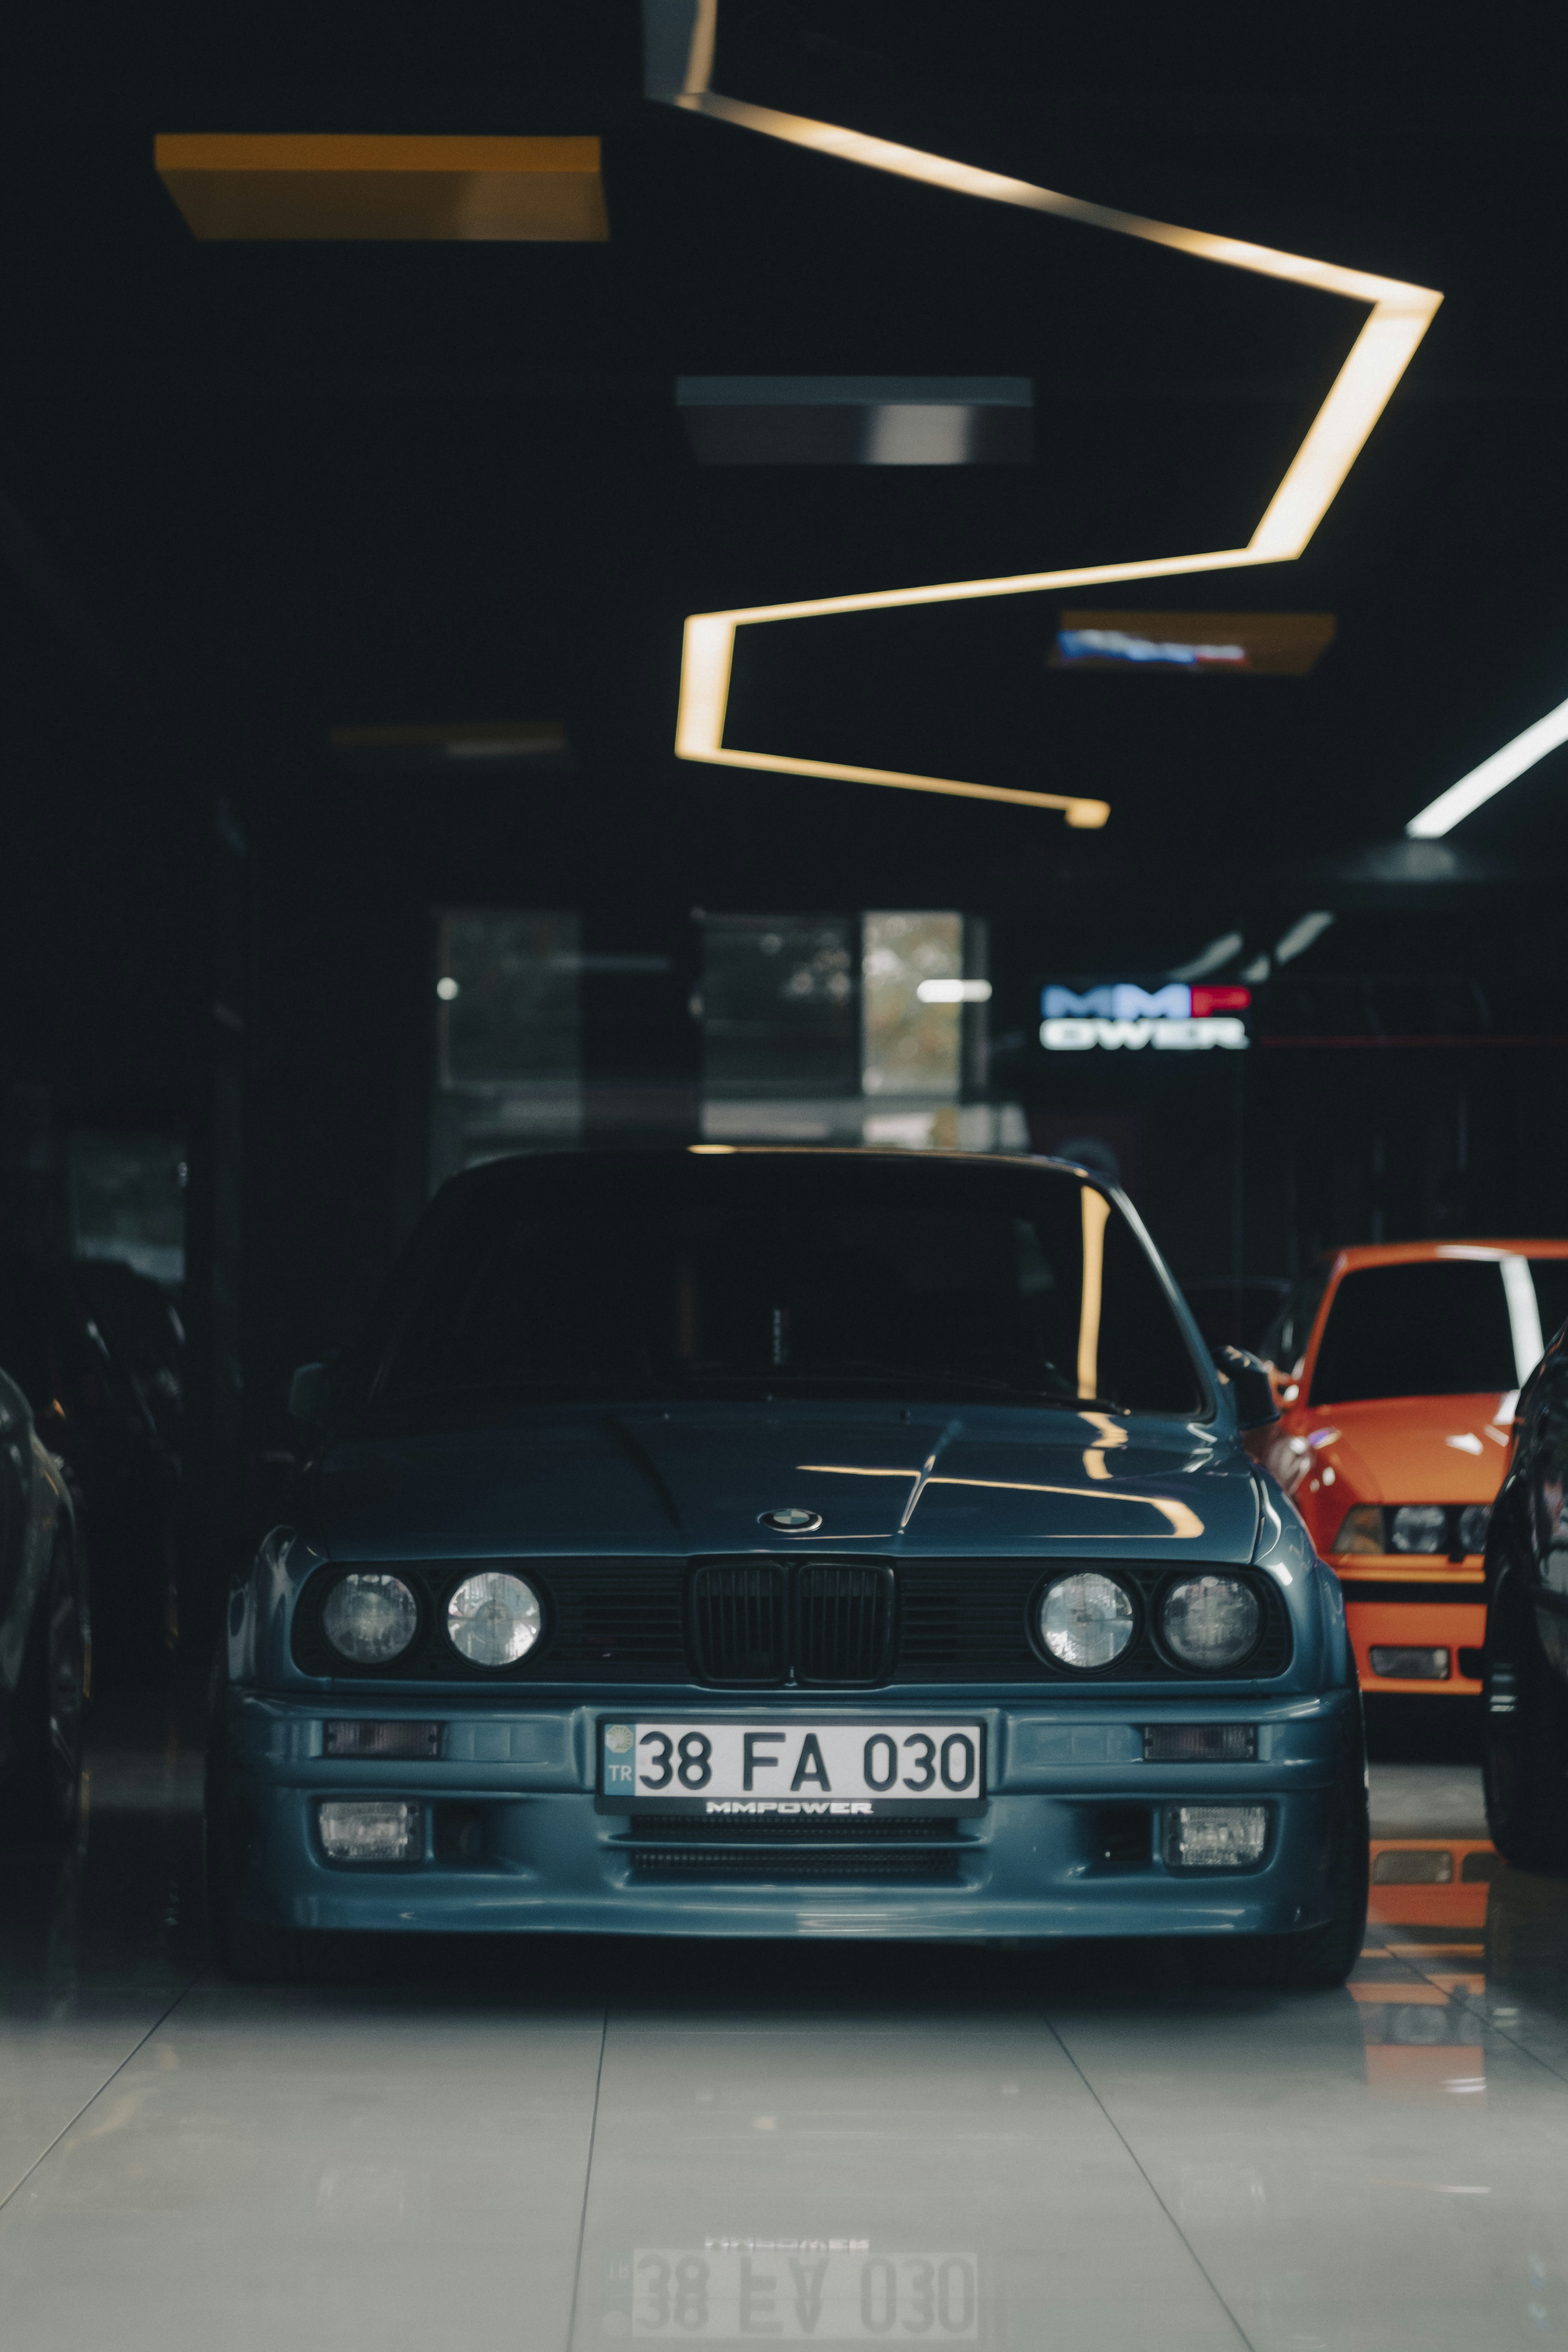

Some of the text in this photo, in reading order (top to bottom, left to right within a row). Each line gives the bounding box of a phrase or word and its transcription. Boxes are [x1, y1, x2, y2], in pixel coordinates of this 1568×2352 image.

[1041, 983, 1250, 1018] MMP
[1040, 1017, 1250, 1050] OWER
[609, 1764, 632, 1781] TR
[639, 1731, 975, 1791] 38 FA 030
[706, 1801, 874, 1814] MMPOWER
